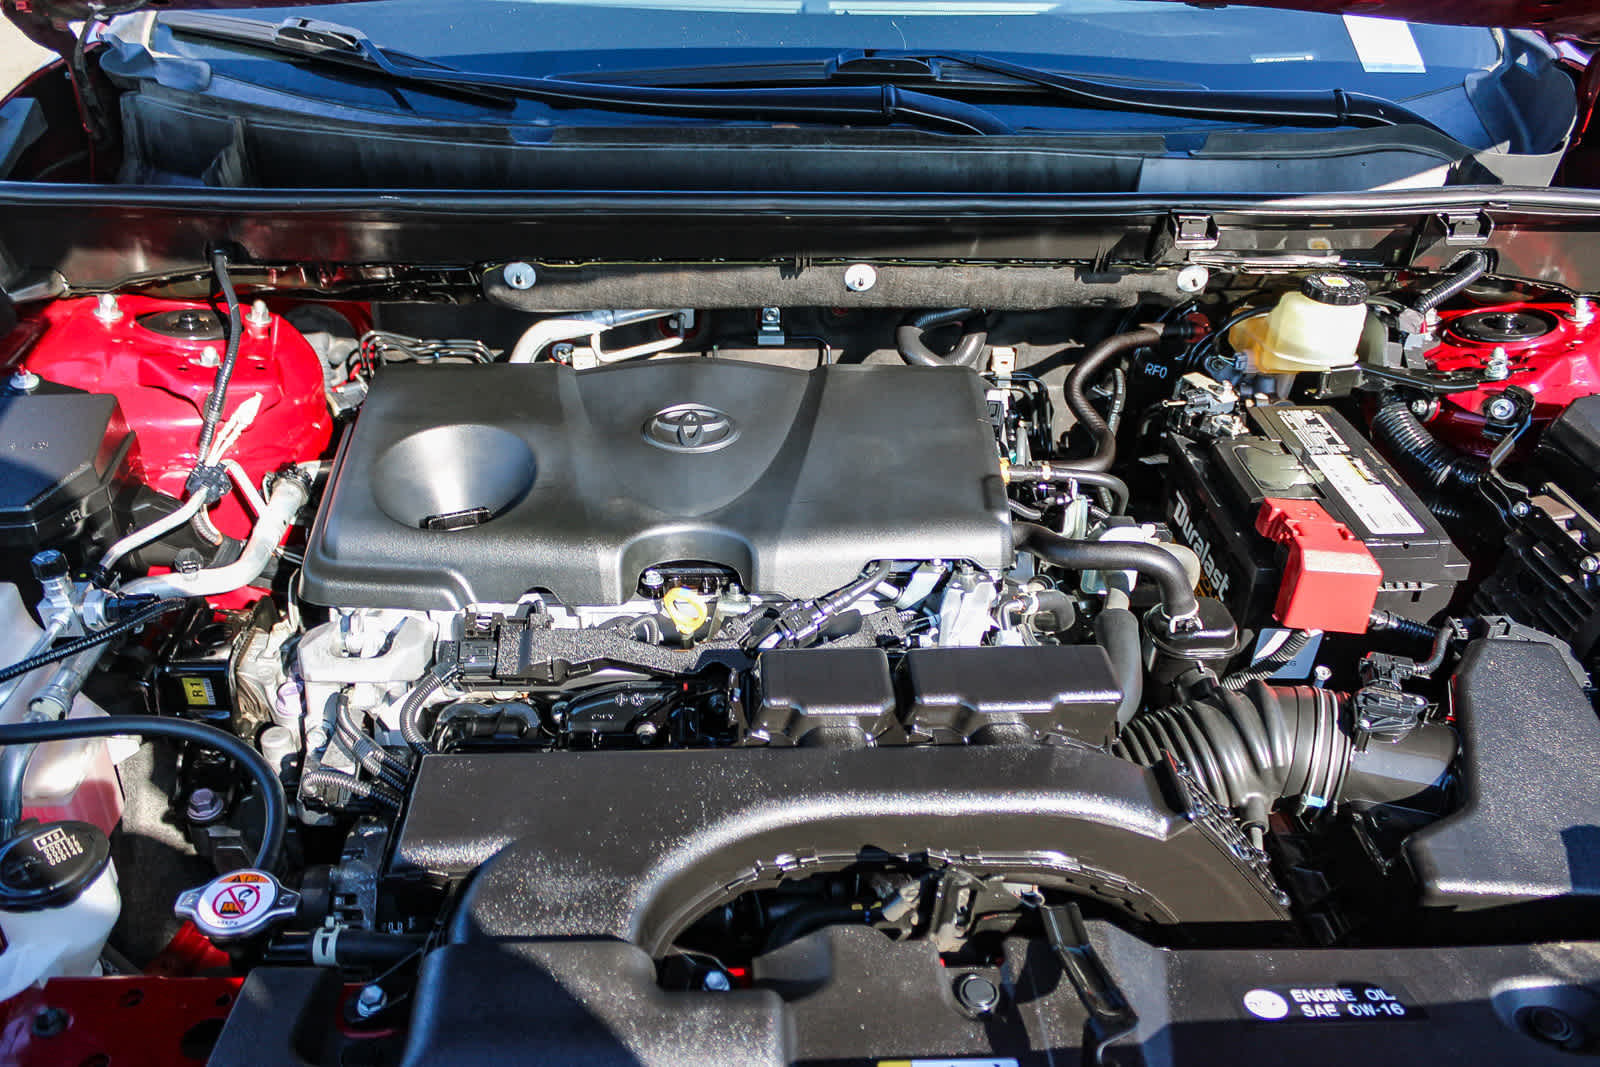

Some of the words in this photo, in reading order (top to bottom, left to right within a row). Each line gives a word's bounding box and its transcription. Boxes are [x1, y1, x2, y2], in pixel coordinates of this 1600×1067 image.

[1174, 489, 1229, 602] Duralast
[1289, 989, 1357, 1002] ENGINE
[1364, 989, 1396, 1001] OIL
[1301, 1004, 1341, 1017] SAE
